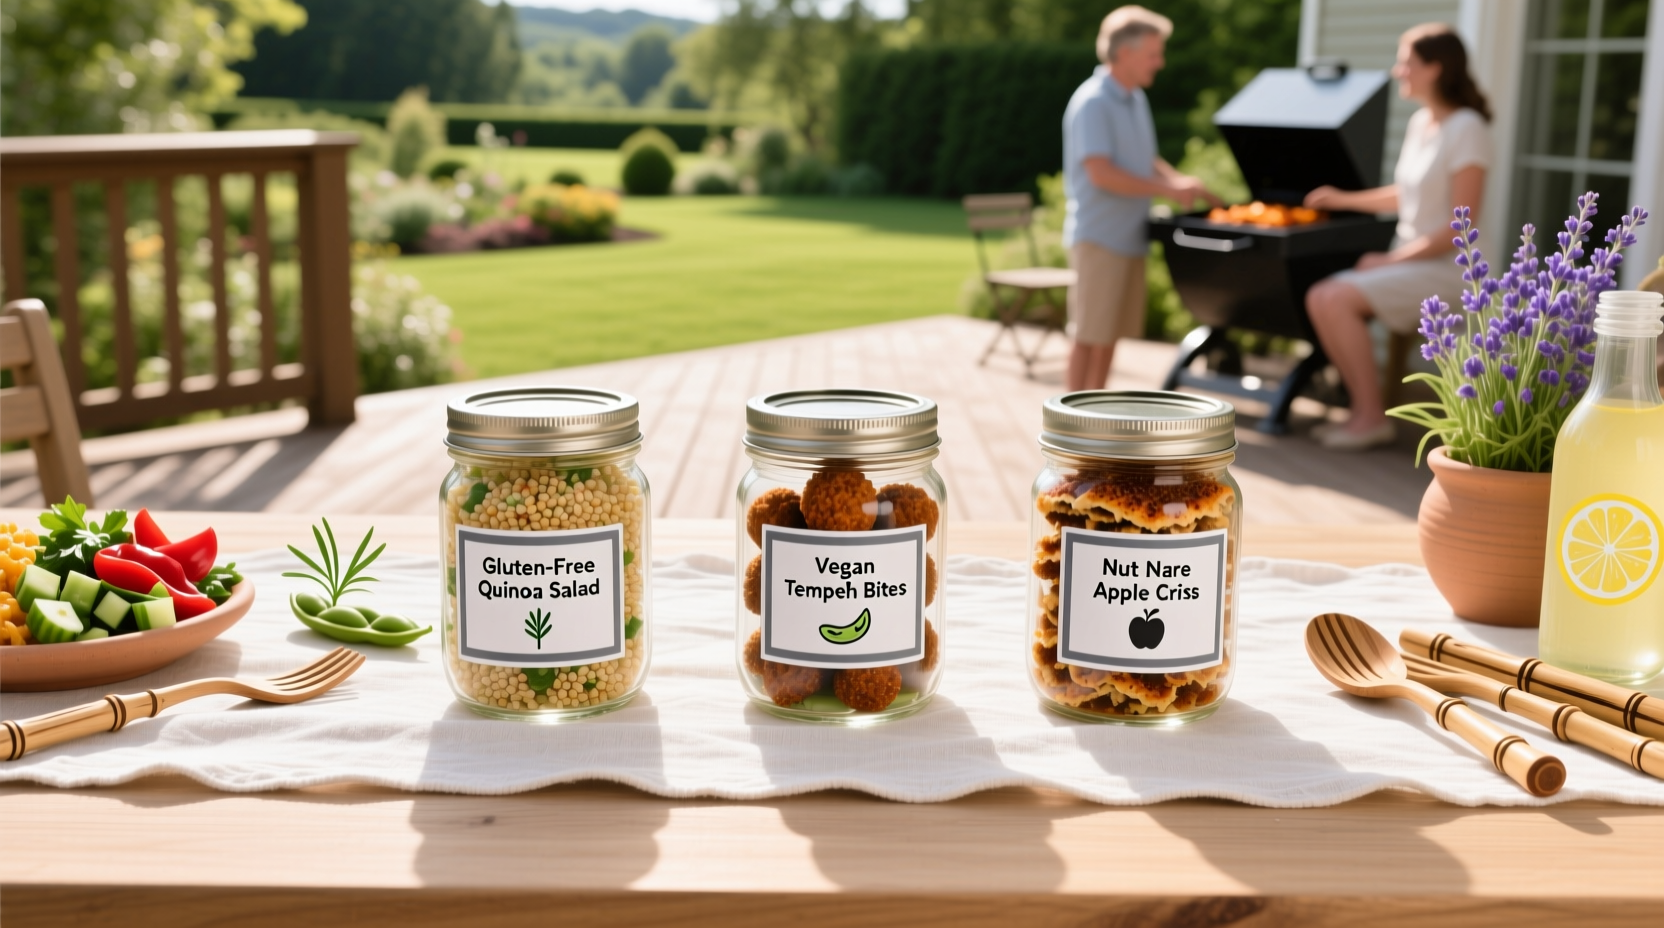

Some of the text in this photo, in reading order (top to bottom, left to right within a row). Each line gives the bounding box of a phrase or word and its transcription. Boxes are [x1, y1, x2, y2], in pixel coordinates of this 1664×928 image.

[482, 556, 596, 576] Gluten-Free
[814, 556, 875, 580] Vegan
[1102, 557, 1191, 578] Nut Nare
[478, 577, 600, 600] Quinoa Salad
[784, 578, 907, 604] Tempeh Bites
[1092, 581, 1200, 606] Apple Criss
